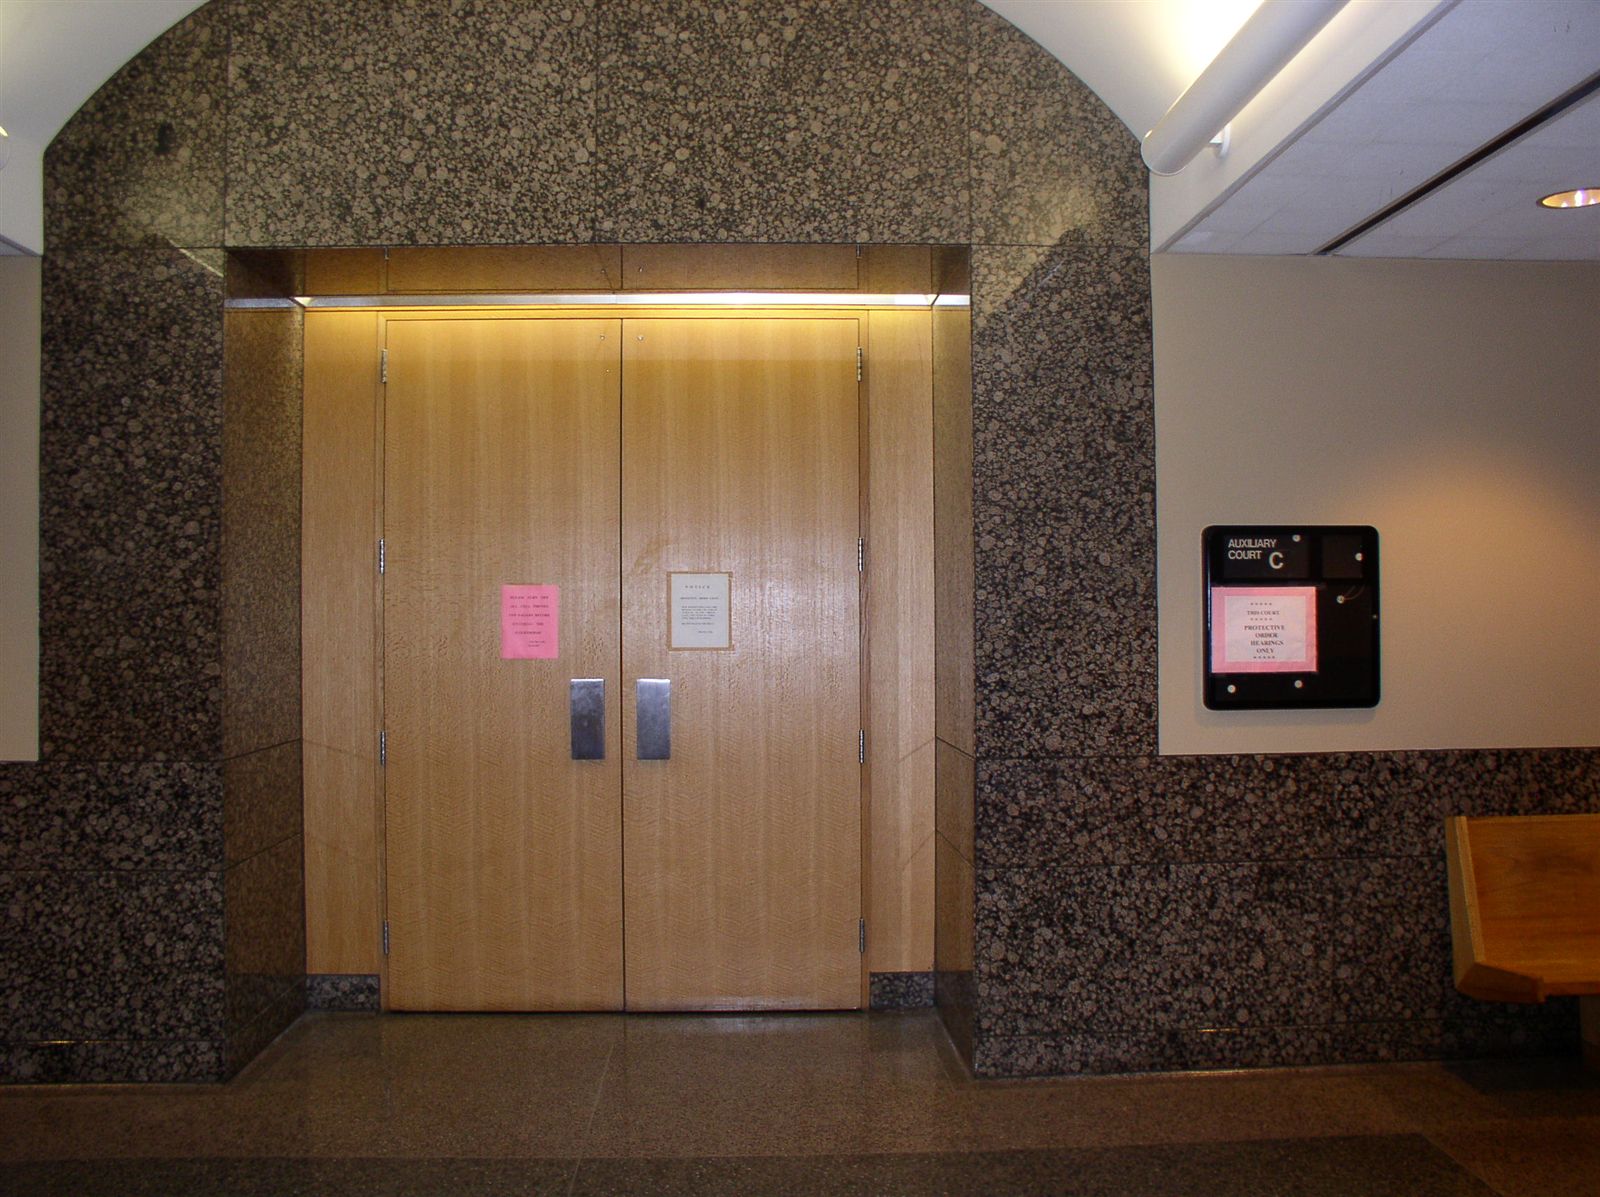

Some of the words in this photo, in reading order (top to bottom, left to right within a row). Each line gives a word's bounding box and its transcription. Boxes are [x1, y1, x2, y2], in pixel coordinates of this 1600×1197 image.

[1228, 538, 1277, 548] AUXILIARY
[1228, 550, 1262, 560] COURT
[1269, 551, 1284, 569] C
